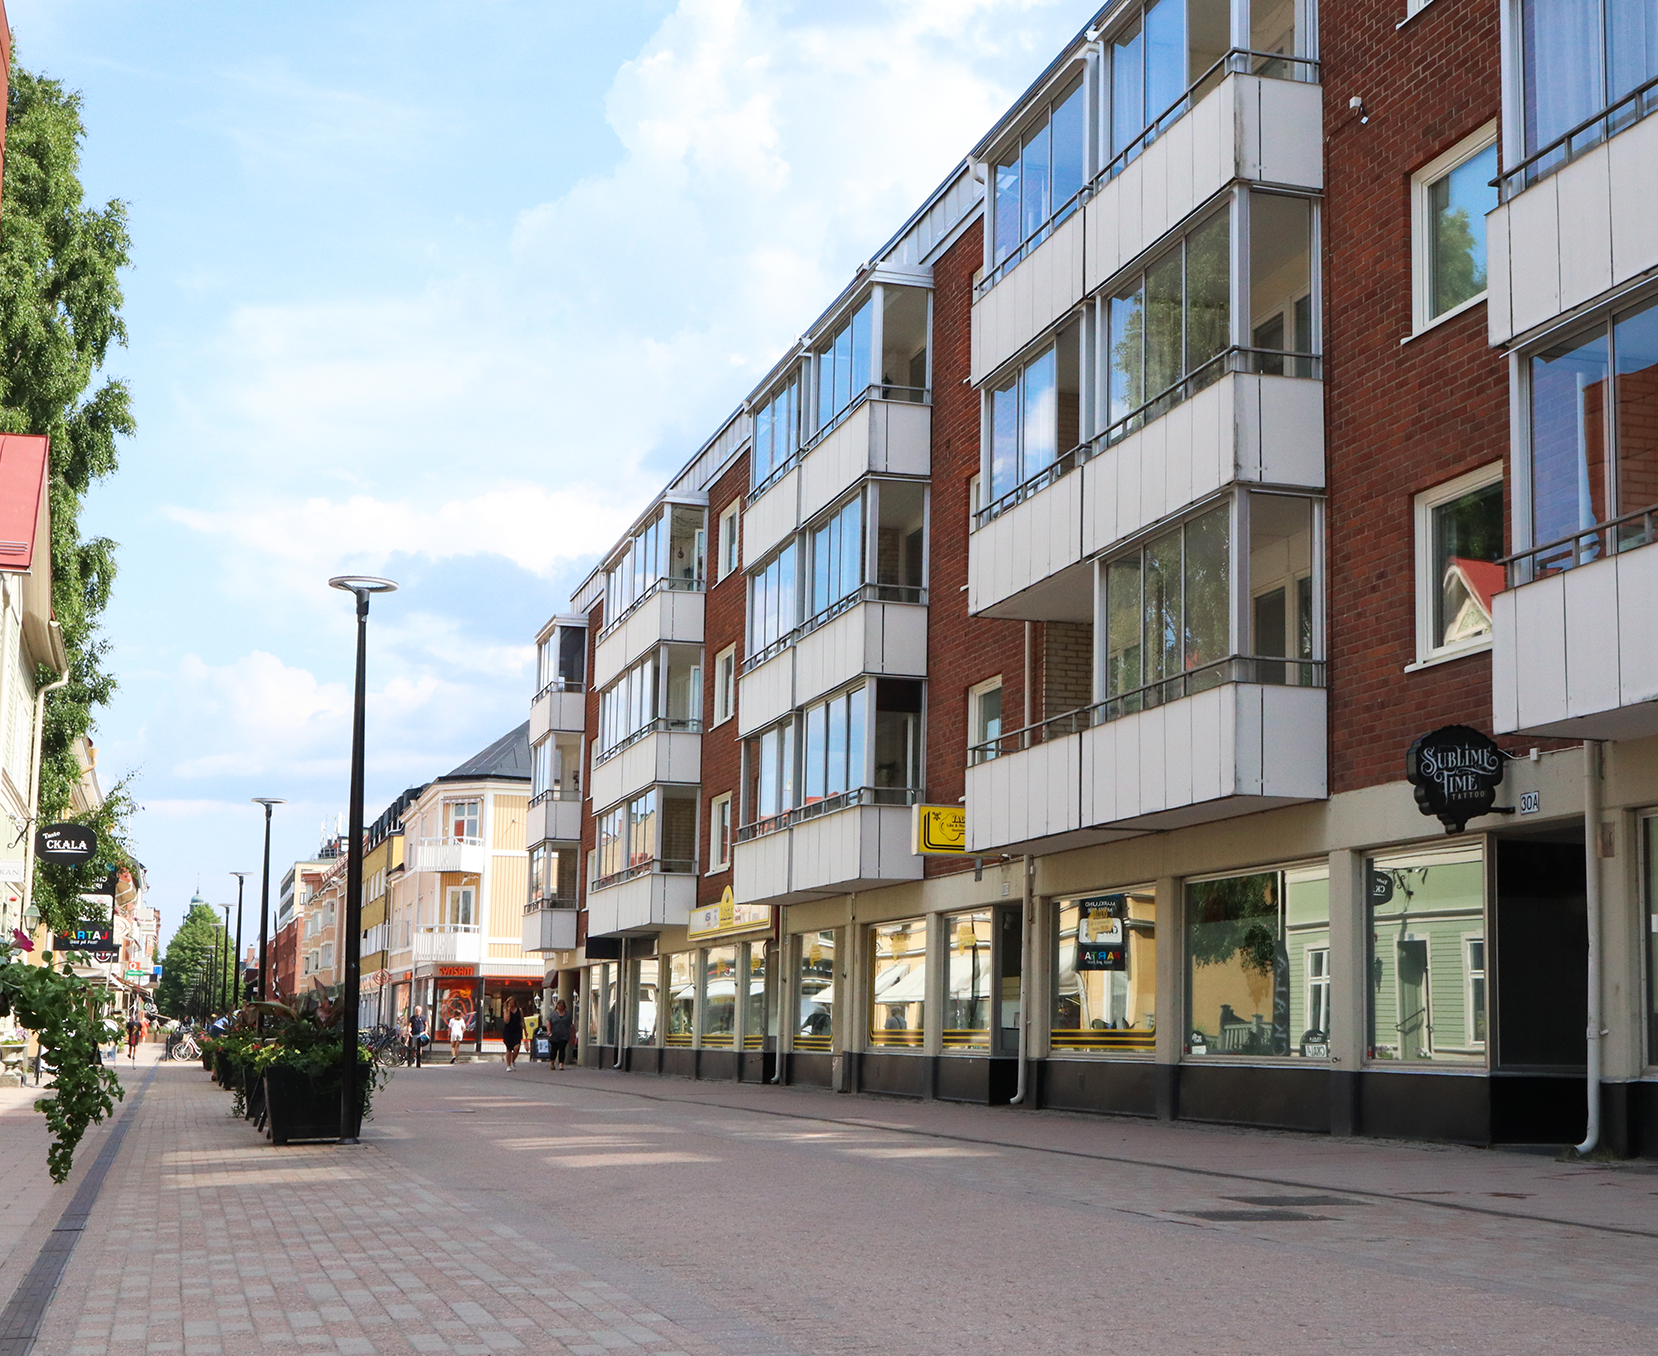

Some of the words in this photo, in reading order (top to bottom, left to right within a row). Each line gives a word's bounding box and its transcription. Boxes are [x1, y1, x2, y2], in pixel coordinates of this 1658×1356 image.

[1421, 745, 1498, 776] SUBLIME
[1434, 769, 1478, 804] TIME
[1451, 790, 1485, 800] TATTOO
[1521, 795, 1539, 811] 30A
[42, 831, 60, 839] Taste
[46, 840, 88, 850] CKALA
[438, 966, 474, 977] SYNSAM
